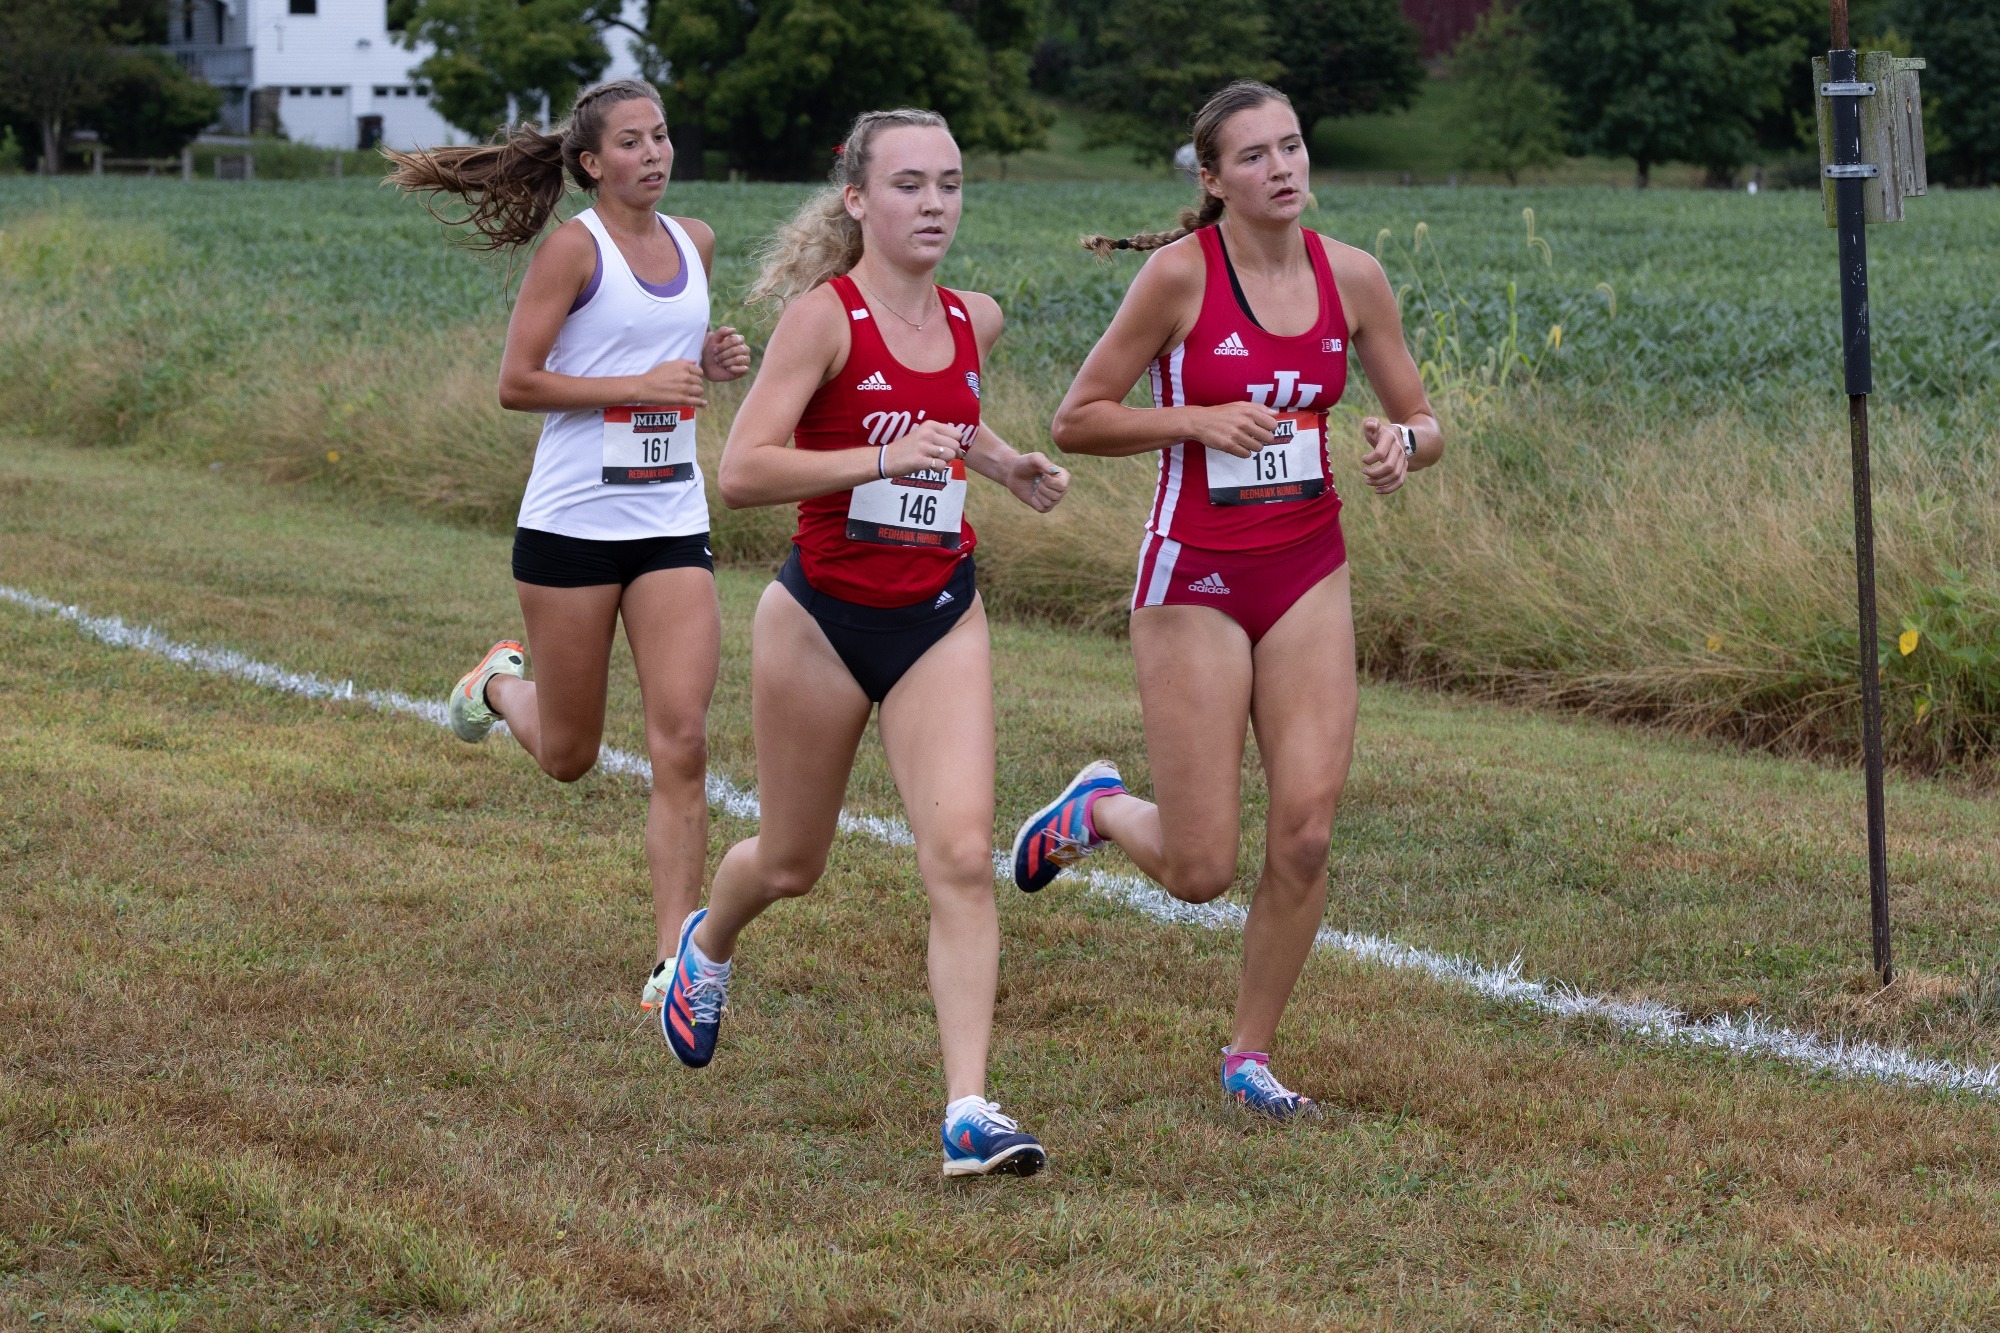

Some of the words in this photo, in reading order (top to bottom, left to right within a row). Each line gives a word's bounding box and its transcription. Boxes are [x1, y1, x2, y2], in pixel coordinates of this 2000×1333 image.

[1213, 346, 1249, 357] adidas
[857, 383, 892, 391] adidas
[636, 413, 676, 426] MIAMI
[642, 437, 669, 463] 161
[1253, 450, 1288, 480] 131
[628, 469, 657, 479] REDHAWK
[1240, 487, 1276, 500] REDHAWK
[1276, 484, 1303, 497] RUMBLE
[899, 492, 937, 526] 146
[878, 527, 916, 542] REDHAWK
[916, 532, 943, 545] RUMBLE
[1188, 584, 1231, 595] adidas
